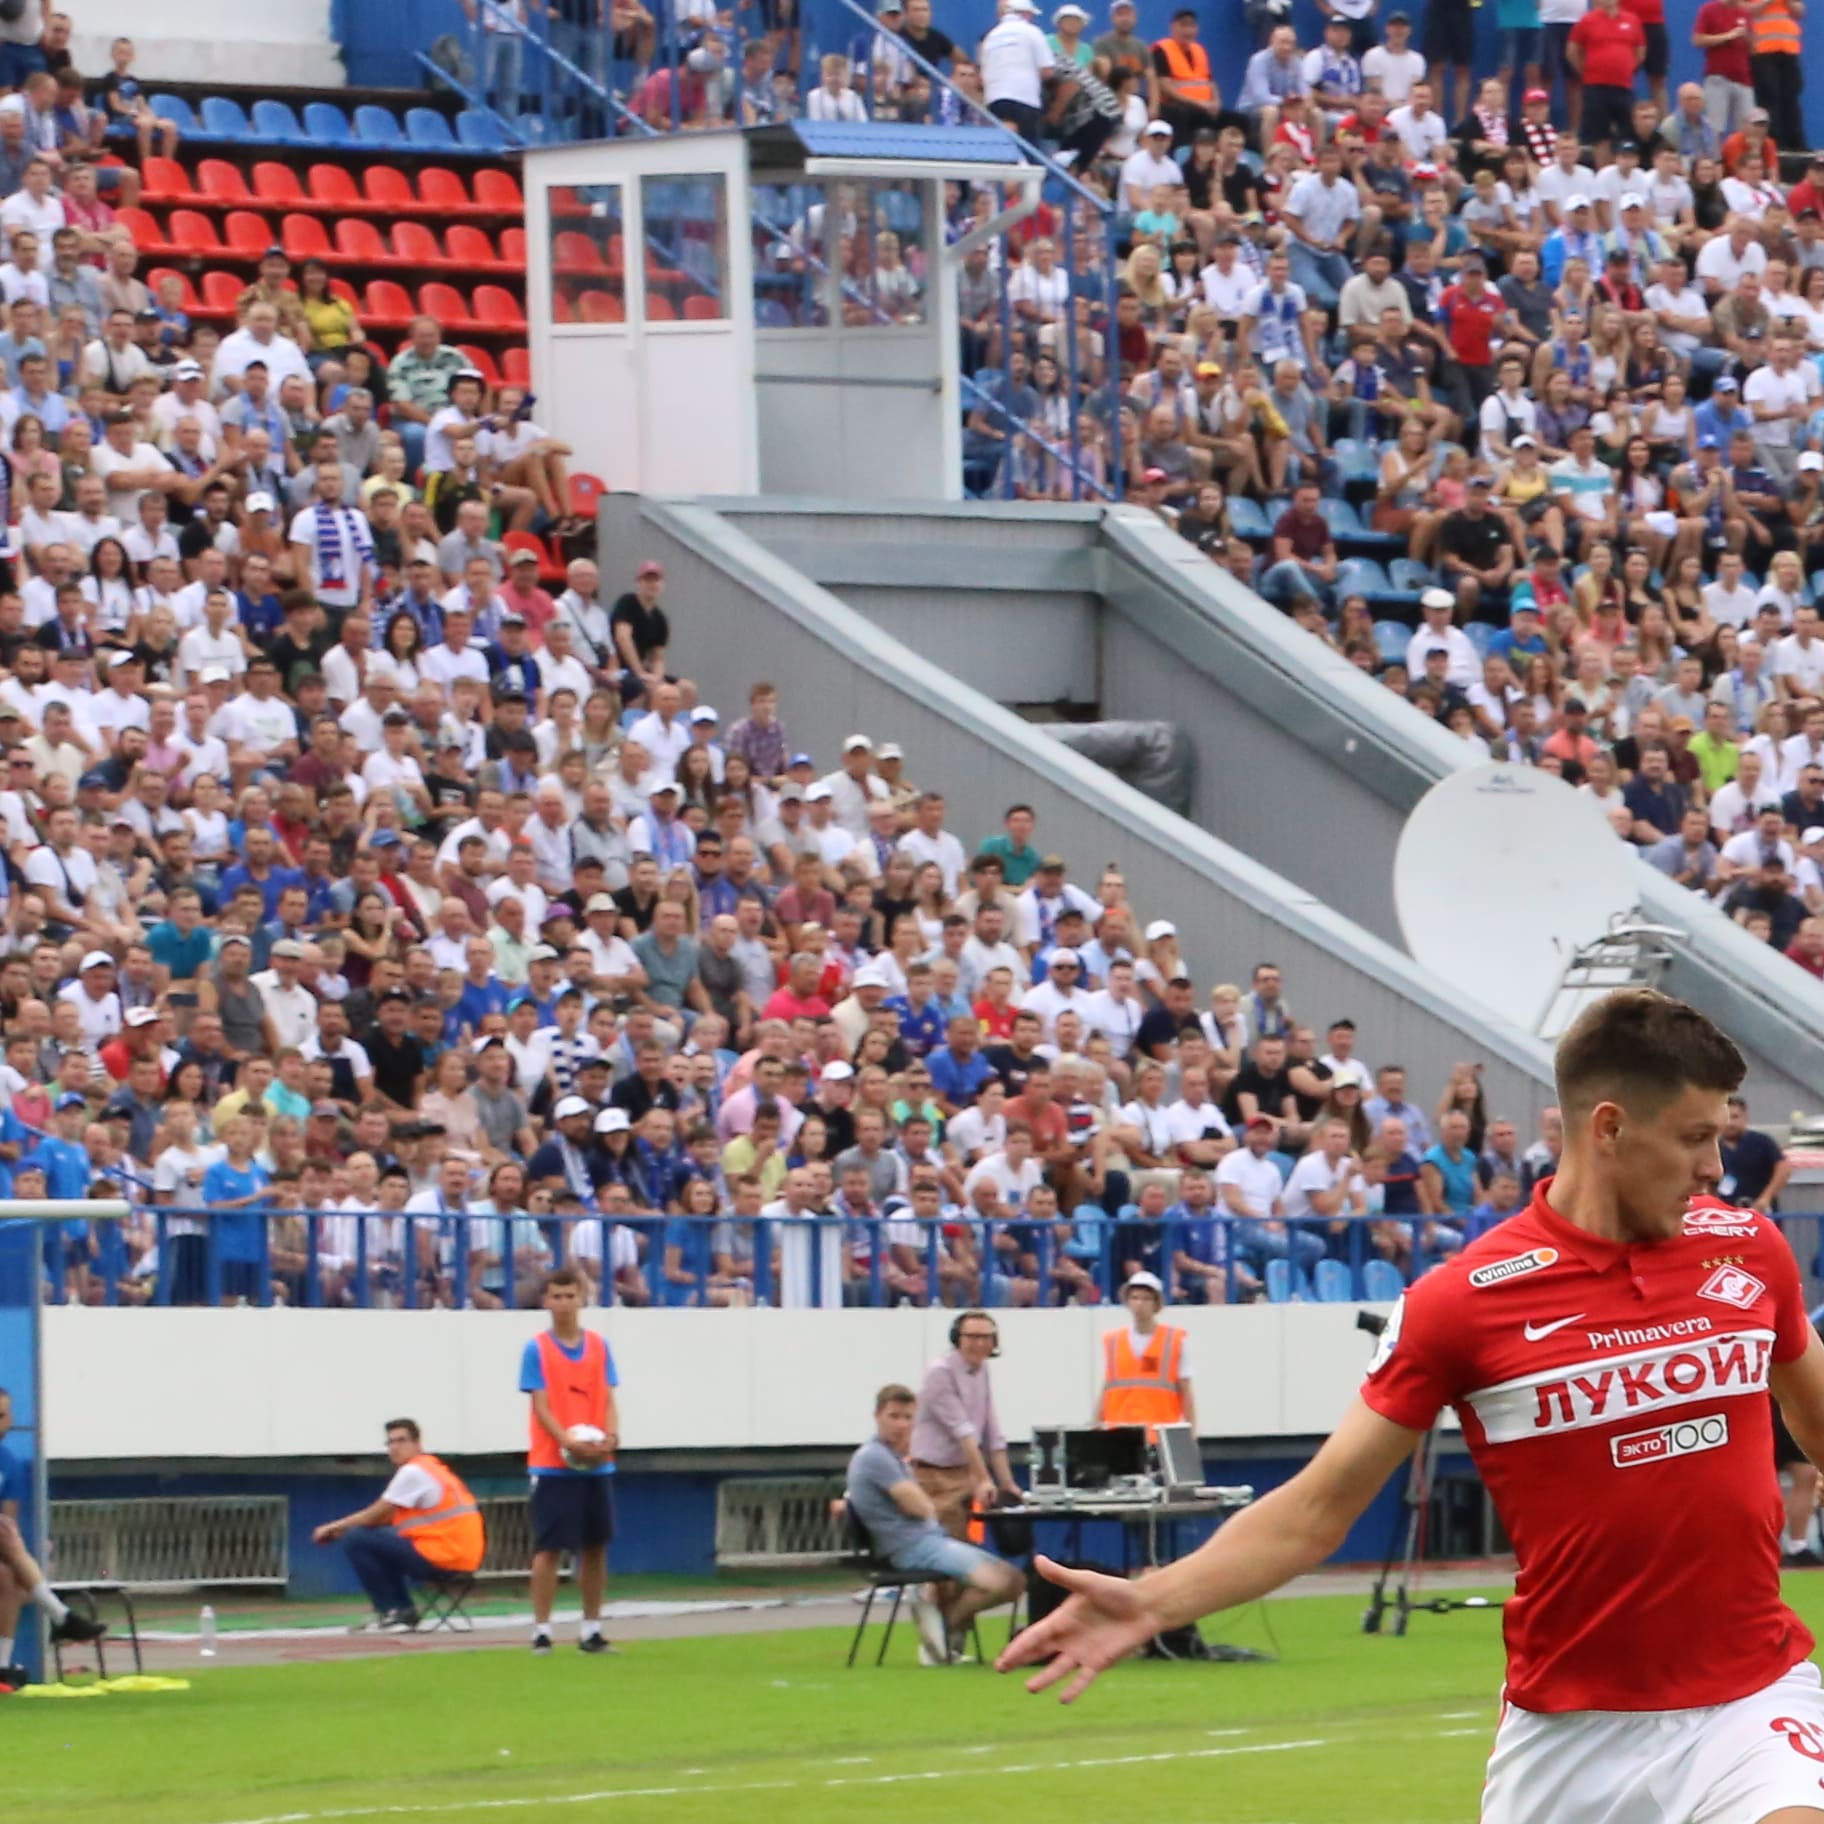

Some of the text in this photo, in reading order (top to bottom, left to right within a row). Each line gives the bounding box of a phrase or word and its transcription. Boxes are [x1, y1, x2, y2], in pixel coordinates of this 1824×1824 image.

[1682, 1226, 1759, 1238] CHERY
[1477, 1258, 1535, 1283] Winline
[1587, 1316, 1712, 1350] Primavera
